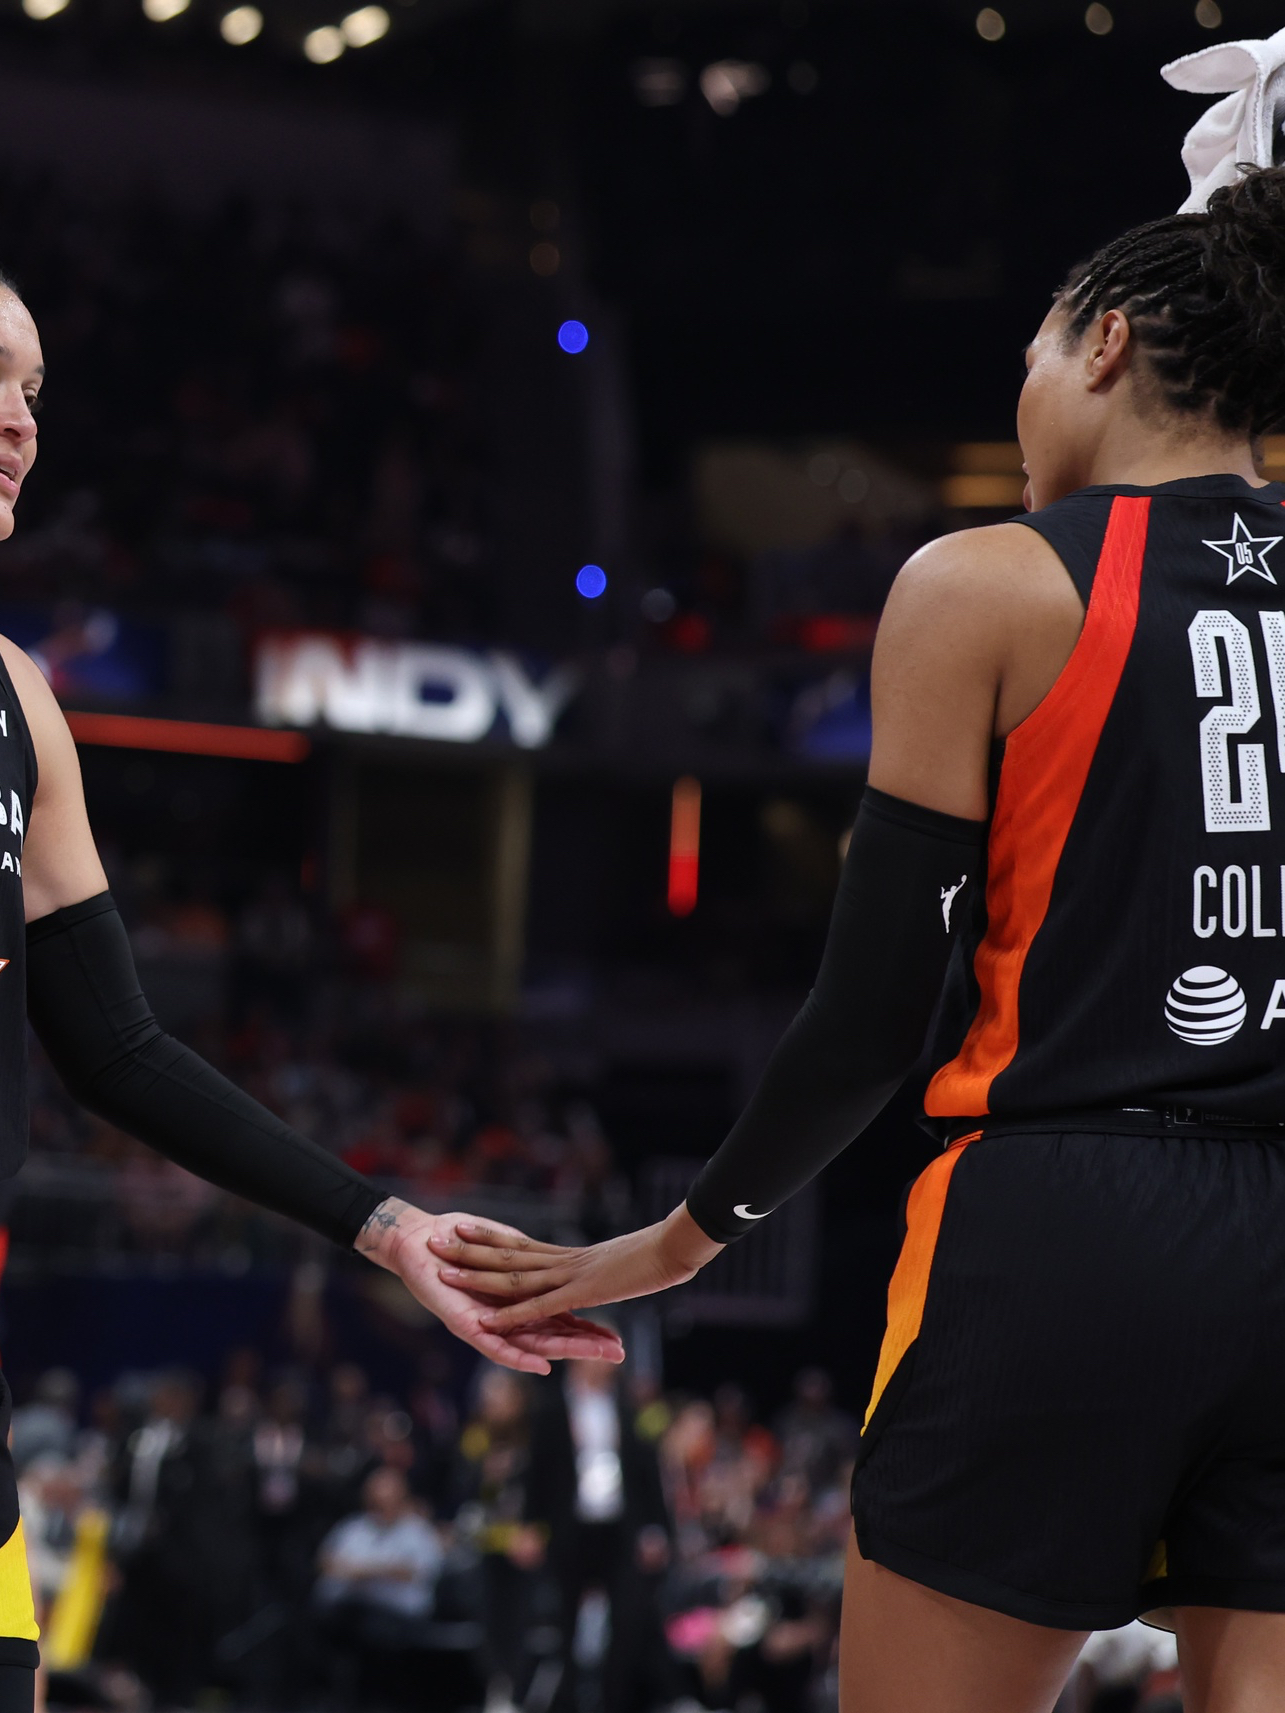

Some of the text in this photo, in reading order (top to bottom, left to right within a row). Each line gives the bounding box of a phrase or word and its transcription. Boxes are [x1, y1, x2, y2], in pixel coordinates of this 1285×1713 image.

[1234, 541, 1254, 566] 05
[254, 637, 584, 748] INDY
[1193, 865, 1285, 938] COL
